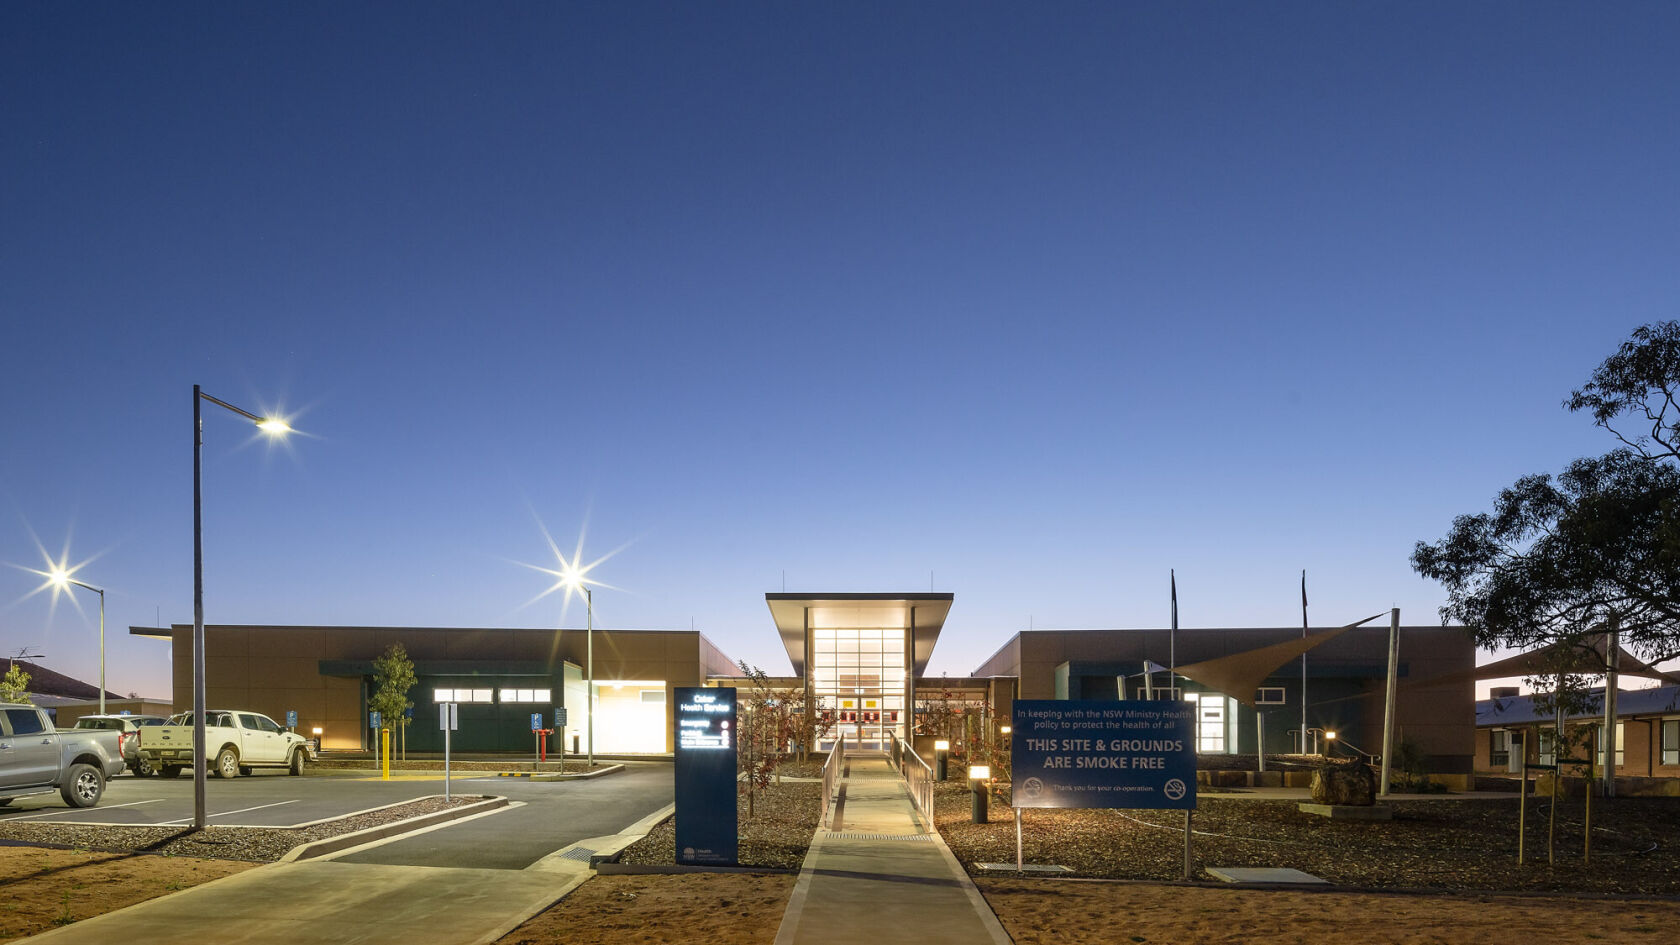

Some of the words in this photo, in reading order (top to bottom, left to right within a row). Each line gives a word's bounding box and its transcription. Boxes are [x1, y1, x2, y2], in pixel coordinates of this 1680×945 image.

[680, 703, 702, 712] Health
[1017, 709, 1026, 718] In
[1028, 709, 1062, 720] keeping
[1065, 709, 1084, 718] with
[1087, 709, 1101, 718] the
[1103, 710, 1123, 719] NSW
[1126, 710, 1160, 721] Ministry
[1163, 710, 1191, 719] Health
[1034, 720, 1059, 730] policy
[1061, 721, 1070, 729] to
[1072, 720, 1104, 730] protect
[1106, 720, 1120, 729] the
[1122, 720, 1150, 729] health
[1152, 720, 1161, 729] of
[1164, 720, 1175, 730] all
[1026, 738, 1058, 751] THIS
[1062, 739, 1091, 752] SITE
[1095, 739, 1106, 752] &
[1110, 739, 1183, 752] GROUNDS
[1043, 756, 1071, 769] ARE
[1076, 756, 1127, 769] SMOKE
[1132, 757, 1165, 769] FREE
[1054, 784, 1073, 792] Thank
[1074, 785, 1085, 793] you
[1087, 784, 1096, 792] for
[1097, 785, 1112, 793] your
